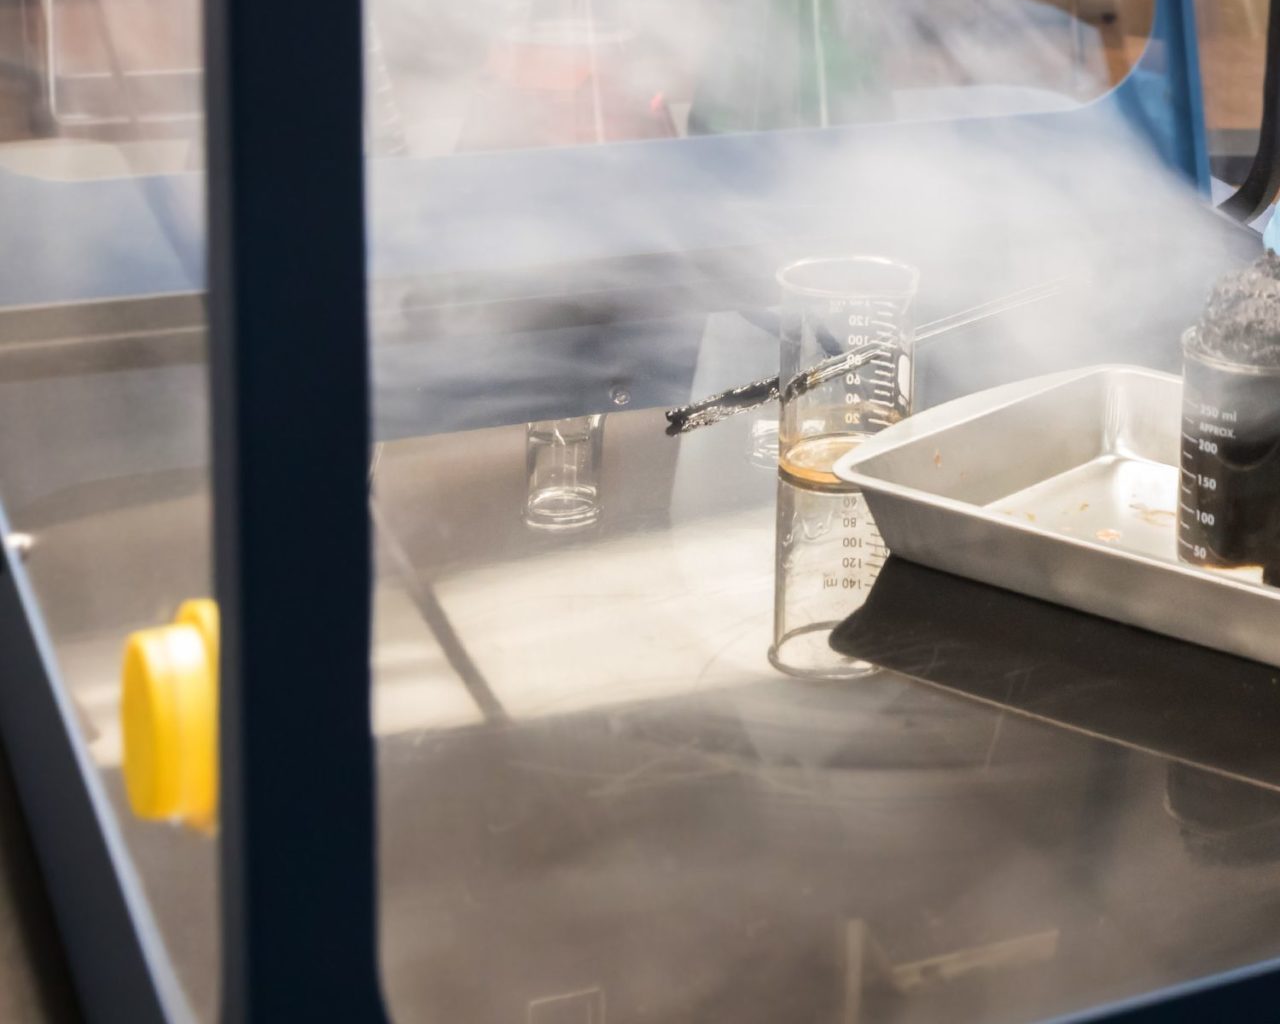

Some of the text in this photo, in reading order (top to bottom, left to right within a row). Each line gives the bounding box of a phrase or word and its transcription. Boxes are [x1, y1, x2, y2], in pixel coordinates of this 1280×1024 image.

[1221, 410, 1237, 422] ml
[1199, 438, 1218, 454] 200
[1197, 474, 1217, 490] 150
[1195, 510, 1215, 526] 100
[842, 537, 863, 548] 100
[1193, 545, 1207, 560] 50
[842, 557, 863, 569] 120
[841, 577, 862, 589] 140
